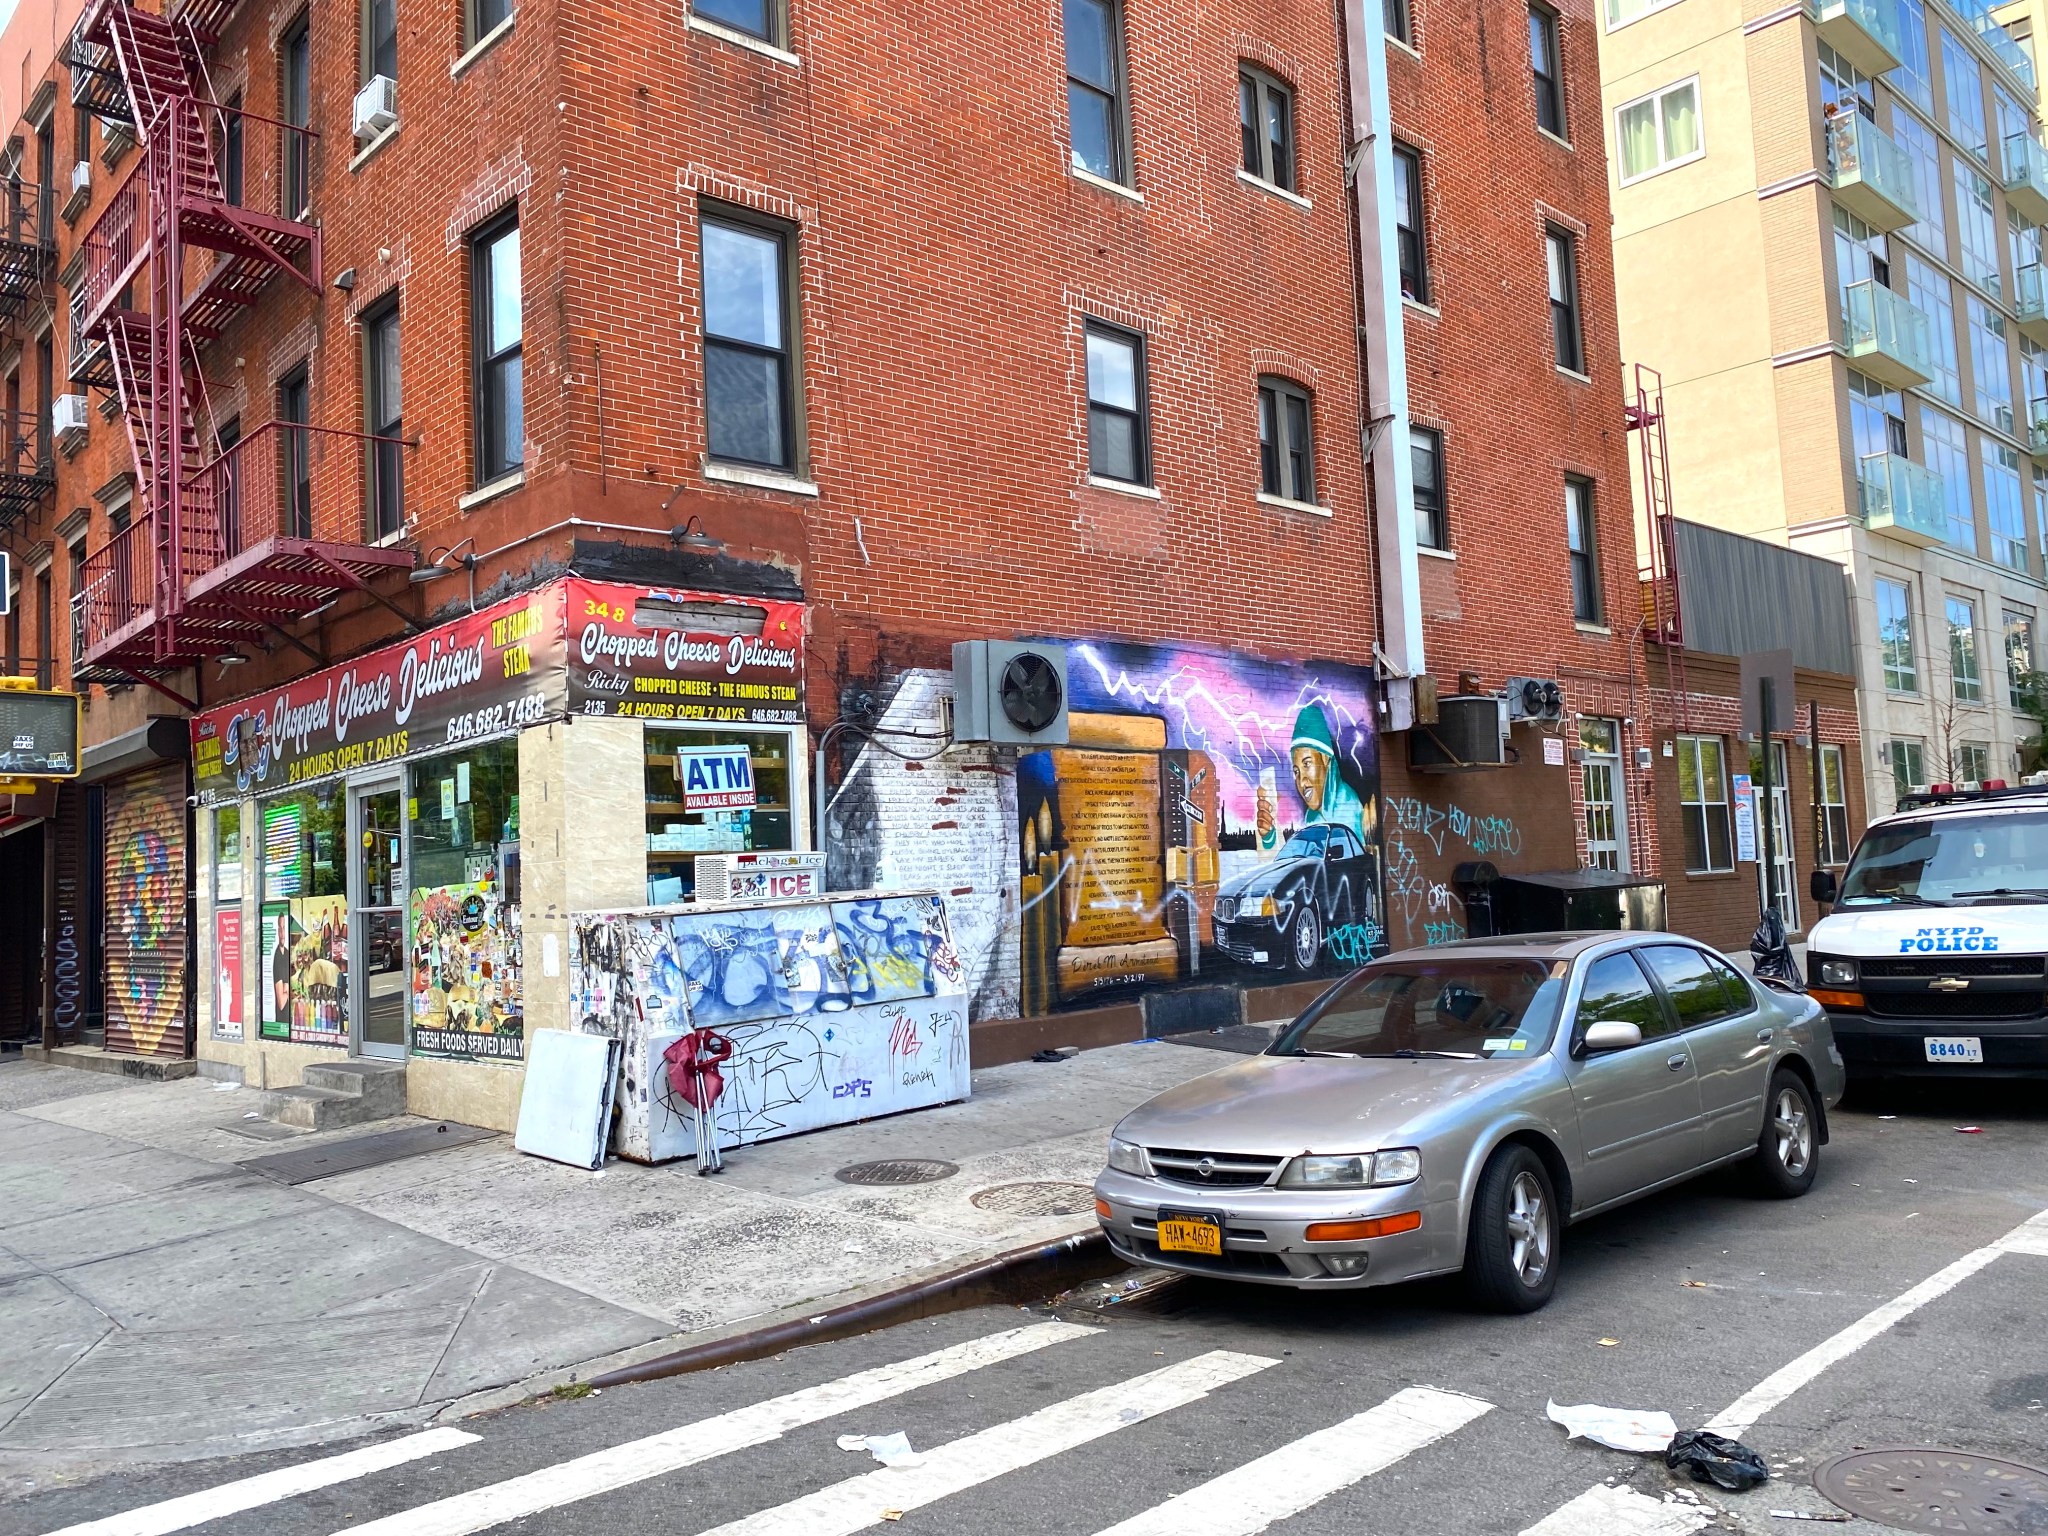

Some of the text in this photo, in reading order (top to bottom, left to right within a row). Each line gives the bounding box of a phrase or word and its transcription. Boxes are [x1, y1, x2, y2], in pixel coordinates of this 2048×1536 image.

[491, 606, 544, 650] THE FAMOUS
[503, 644, 531, 679] STEAK
[580, 622, 796, 674] Chopped Cheese Delicious
[272, 633, 486, 761] Chopped Cheese Delicious
[584, 669, 796, 701] Ricky CHOPPED CHEESE THE FAMOUS STEAK
[447, 692, 545, 743] 646.682.7488
[584, 700, 606, 715] 2135
[618, 702, 633, 715] 24
[635, 703, 674, 718] HOURS
[677, 704, 704, 719] OPEN
[706, 706, 716, 719] 7
[716, 707, 746, 720] DAYS
[289, 730, 408, 784] 24 HOURS OPEN 7 DAYS
[687, 756, 751, 791] ATM
[686, 792, 755, 808] AVAILABLE INSIDE
[805, 855, 823, 865] ice
[770, 875, 811, 898] ICE
[1900, 937, 1998, 952] POLICE
[1916, 927, 1984, 936] NYPD
[1103, 954, 1117, 968] M
[417, 1030, 523, 1057] FRESH FOODS SERVED DAILY
[1930, 1044, 1965, 1056] 8840
